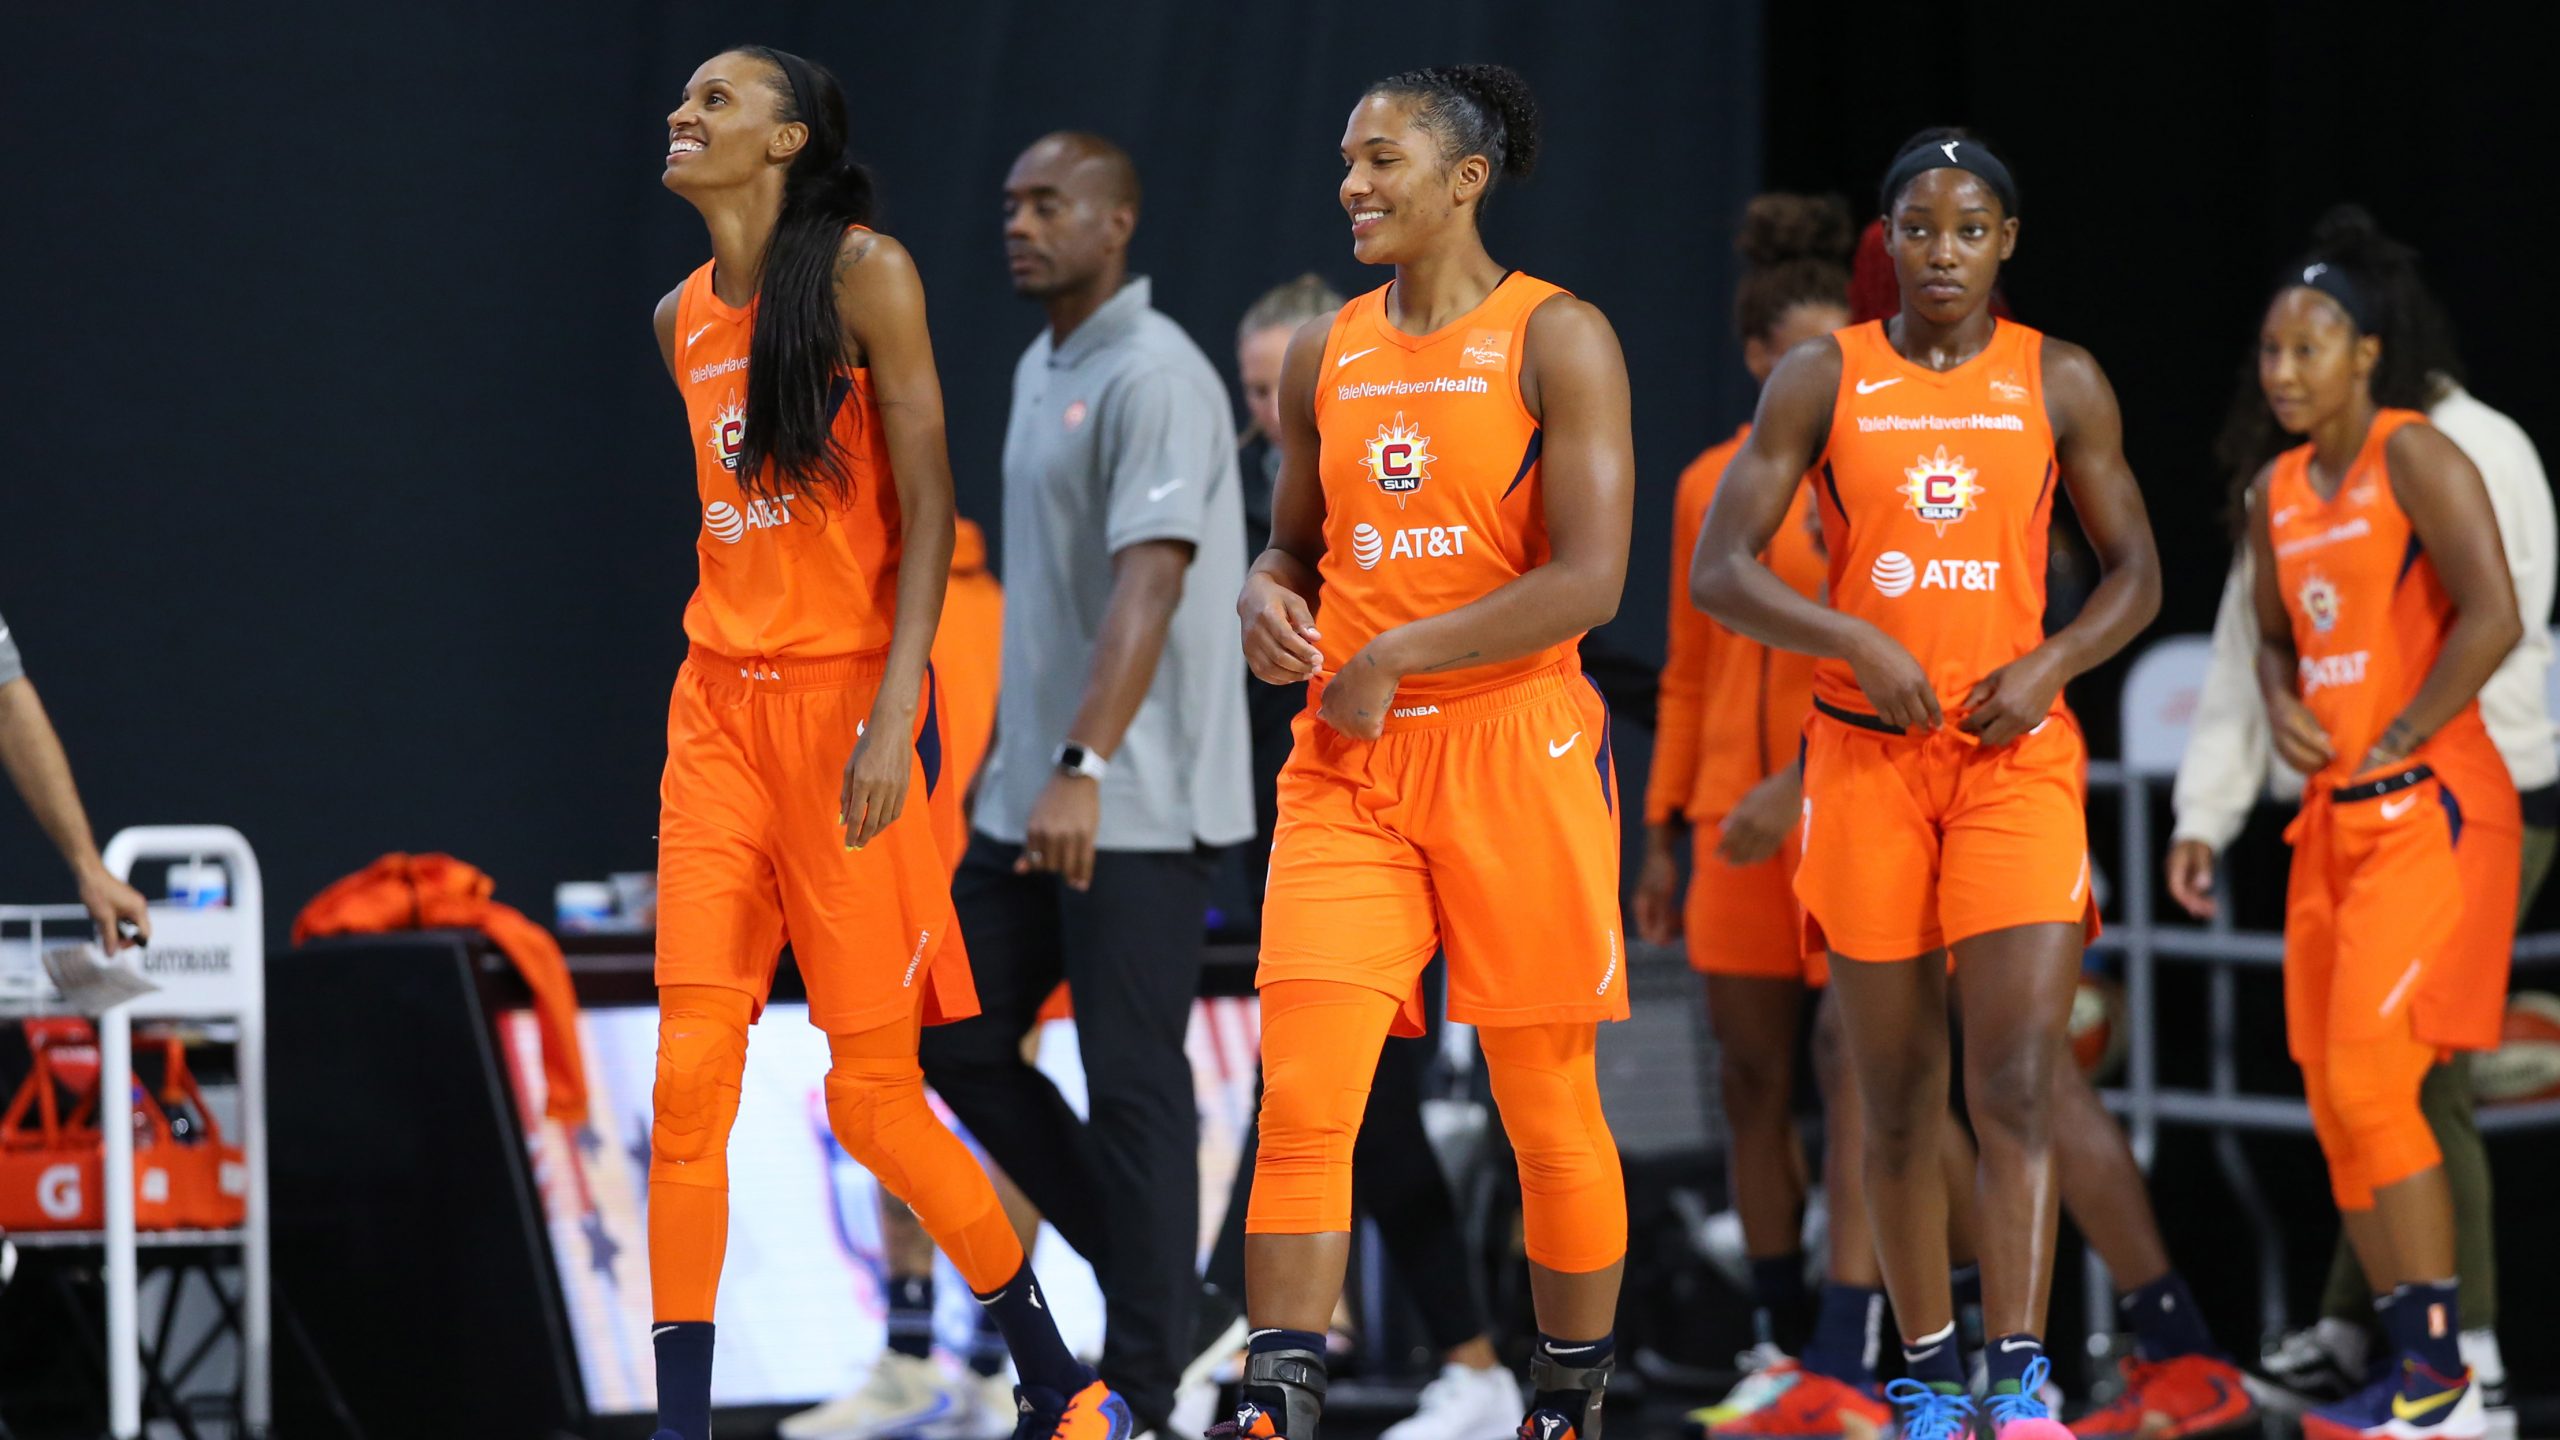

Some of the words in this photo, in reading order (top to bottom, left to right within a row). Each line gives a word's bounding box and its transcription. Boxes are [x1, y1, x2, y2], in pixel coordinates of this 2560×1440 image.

[689, 355, 752, 385] YaleNewHave
[1337, 375, 1488, 401] YaleNewHavenHealth
[1856, 413, 2024, 433] YaleNewHavenHealth
[1381, 443, 1413, 477] C
[1383, 478, 1416, 491] SUN
[1924, 475, 1957, 504] C
[1921, 507, 1959, 519] SUN
[1389, 525, 1469, 560] AT&T
[1920, 559, 2001, 591] AT&T
[1393, 704, 1440, 718] WNBA
[37, 1163, 83, 1221] G
